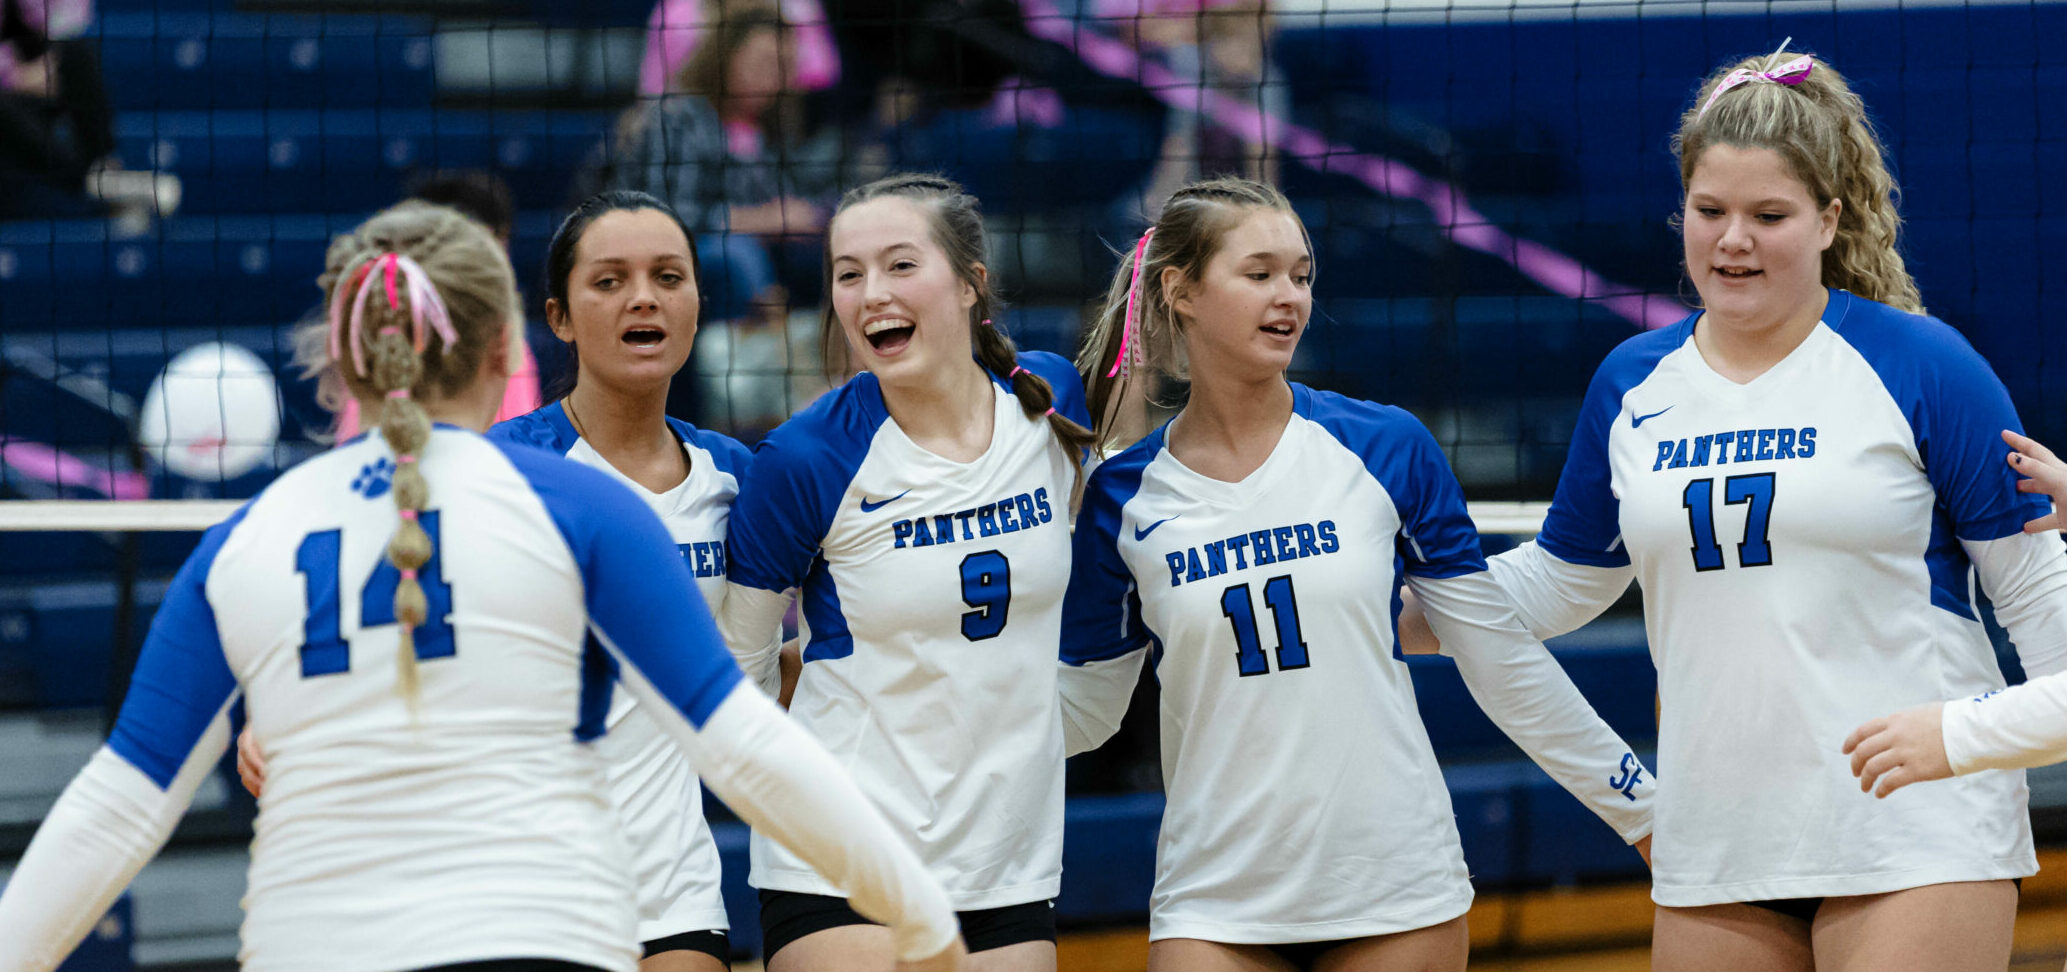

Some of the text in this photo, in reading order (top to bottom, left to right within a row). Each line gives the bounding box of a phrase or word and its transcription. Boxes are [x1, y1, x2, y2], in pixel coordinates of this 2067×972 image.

[1652, 427, 1817, 472] PANTHERS
[892, 487, 1053, 549] PANTHERS
[1165, 519, 1340, 588] PANTHERS
[1682, 471, 1776, 572] 17
[294, 508, 456, 679] 14
[959, 549, 1012, 642] 9
[1220, 573, 1311, 678] 11
